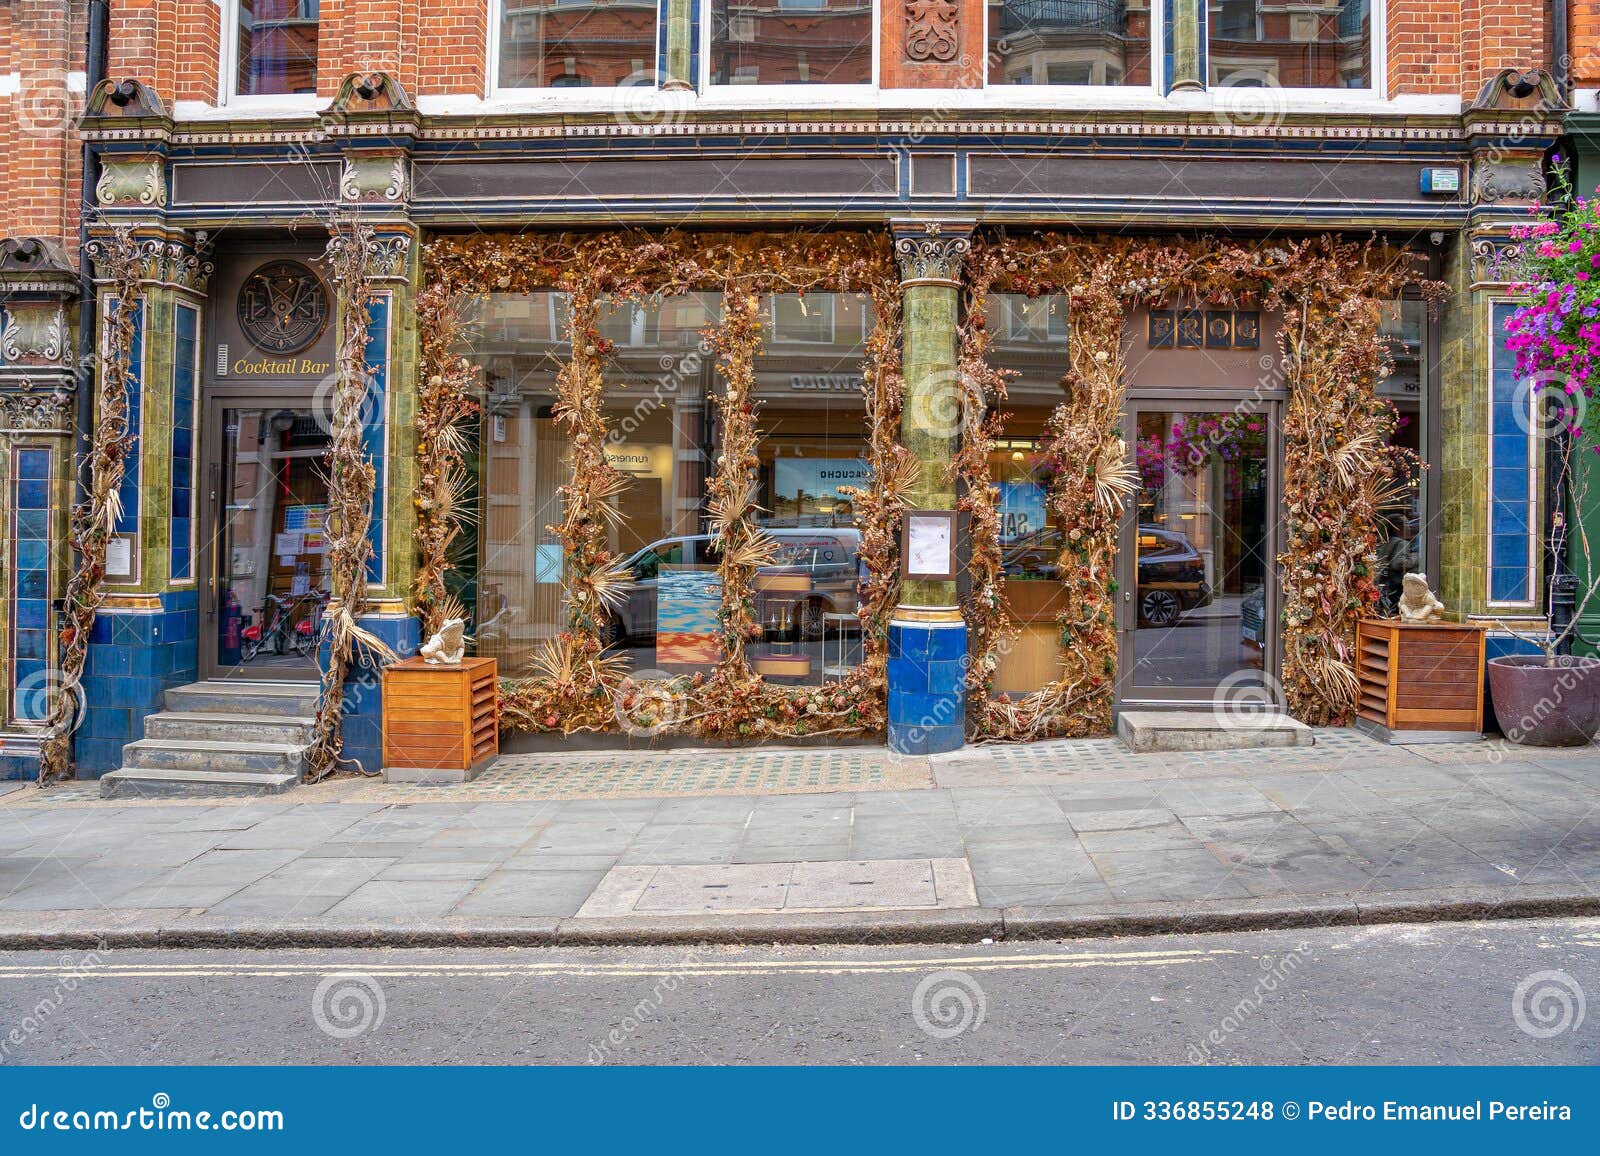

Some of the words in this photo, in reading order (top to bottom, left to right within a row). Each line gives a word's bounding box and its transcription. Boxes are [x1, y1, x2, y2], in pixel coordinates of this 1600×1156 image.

[1152, 317, 1257, 340] FROG
[233, 358, 297, 375] Cocktail
[300, 359, 330, 375] Bar
